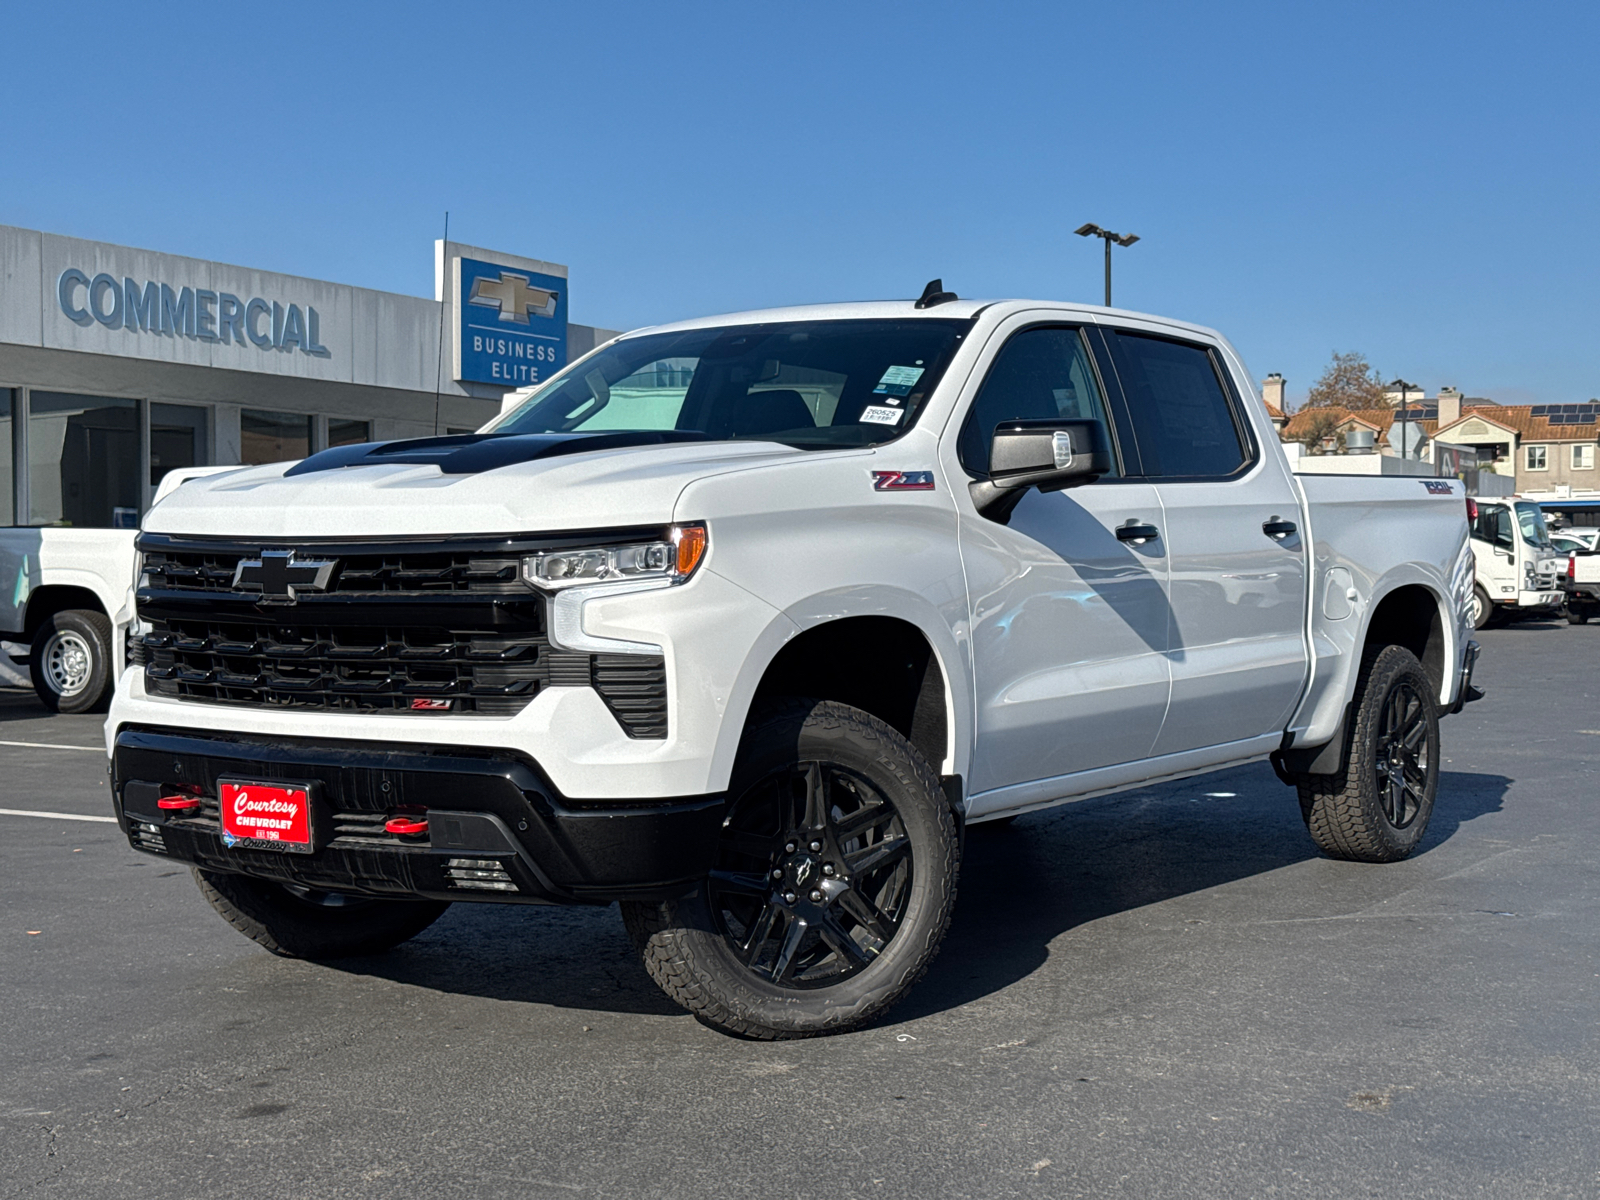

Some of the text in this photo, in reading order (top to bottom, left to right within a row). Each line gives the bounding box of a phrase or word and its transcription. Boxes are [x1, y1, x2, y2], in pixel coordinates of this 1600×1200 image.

[57, 267, 328, 355] COMMERCIAL
[473, 335, 556, 363] BUSINESS
[492, 361, 539, 383] ELITE
[410, 698, 454, 710] Z71
[233, 791, 299, 819] Courtesy
[235, 815, 294, 830] CHEVROLET
